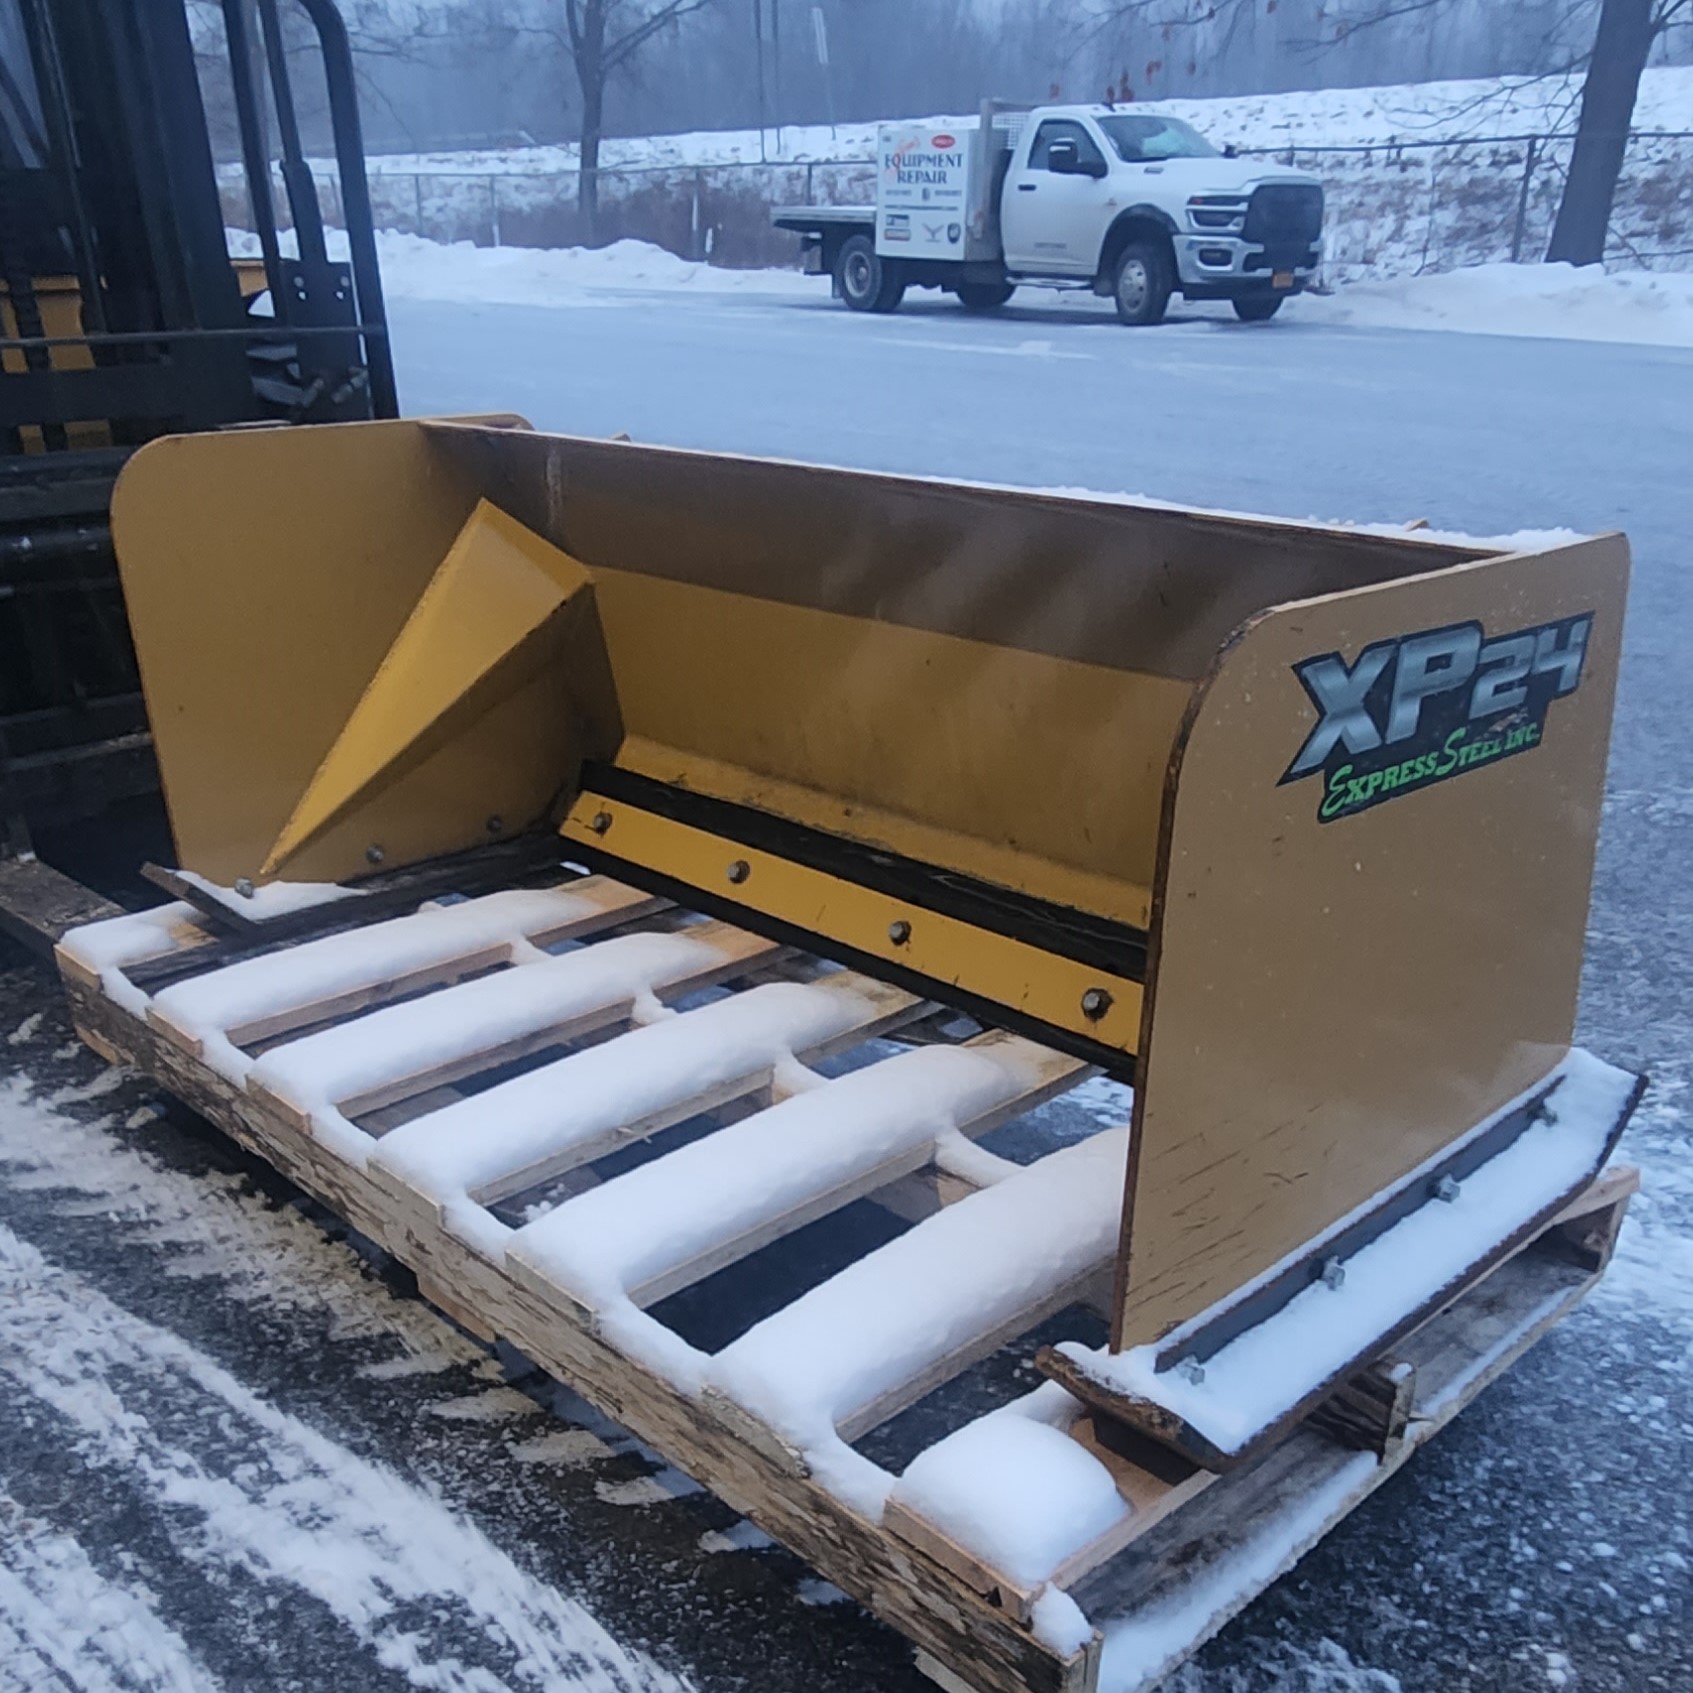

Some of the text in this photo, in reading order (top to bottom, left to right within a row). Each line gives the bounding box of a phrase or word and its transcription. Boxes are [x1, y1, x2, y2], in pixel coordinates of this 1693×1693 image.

[885, 153, 963, 169] EQUIPMENT
[897, 170, 947, 184] REPAIR
[1286, 615, 1590, 778] XP24
